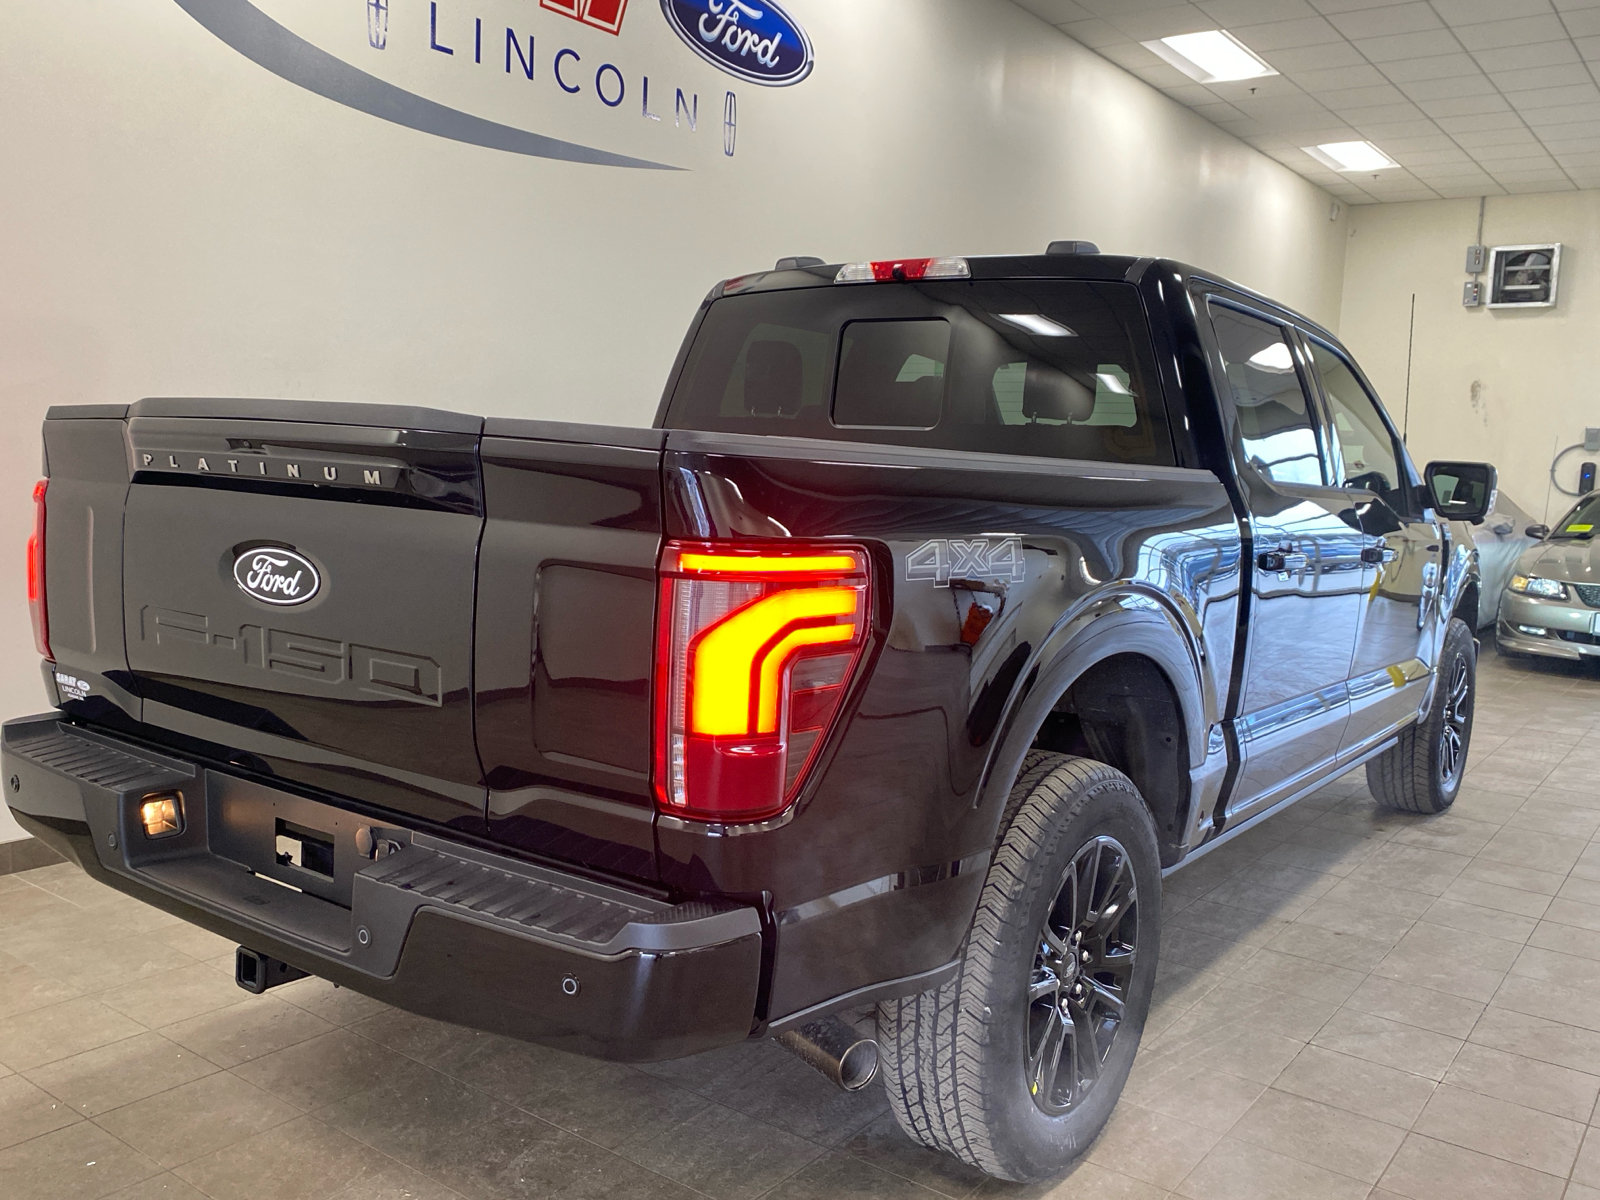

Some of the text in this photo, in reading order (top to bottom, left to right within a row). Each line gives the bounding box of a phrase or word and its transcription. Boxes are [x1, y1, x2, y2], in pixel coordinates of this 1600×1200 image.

[698, 0, 783, 68] Ford
[429, 2, 698, 132] LINCOLN
[143, 453, 381, 485] PLATINUM
[246, 554, 302, 596] Ford
[140, 604, 442, 707] F-150
[62, 685, 87, 697] LINCOLN
